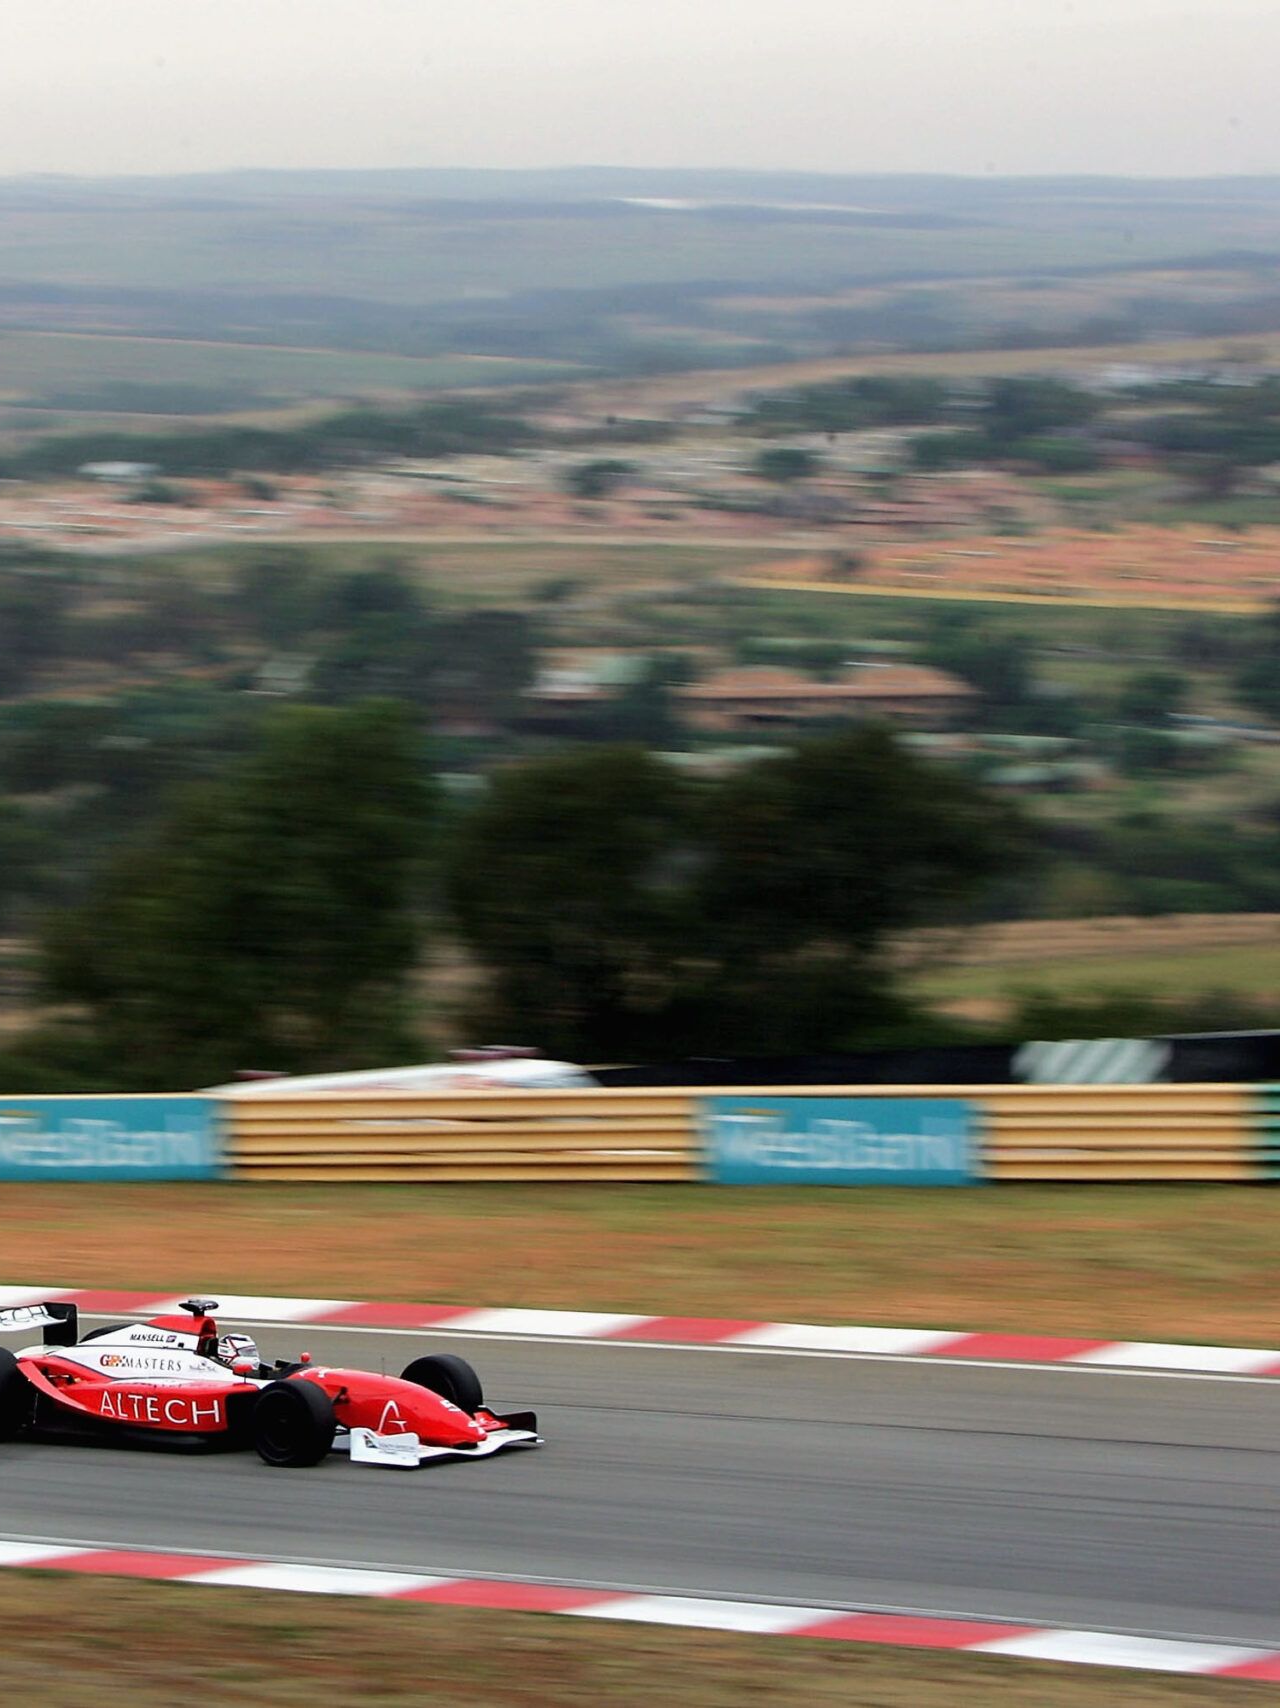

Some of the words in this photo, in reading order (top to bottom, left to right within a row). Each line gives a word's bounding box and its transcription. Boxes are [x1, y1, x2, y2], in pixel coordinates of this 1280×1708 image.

[130, 1334, 165, 1342] MANSELL
[125, 1357, 182, 1371] MASTERS
[100, 1390, 220, 1425] ALTECH
